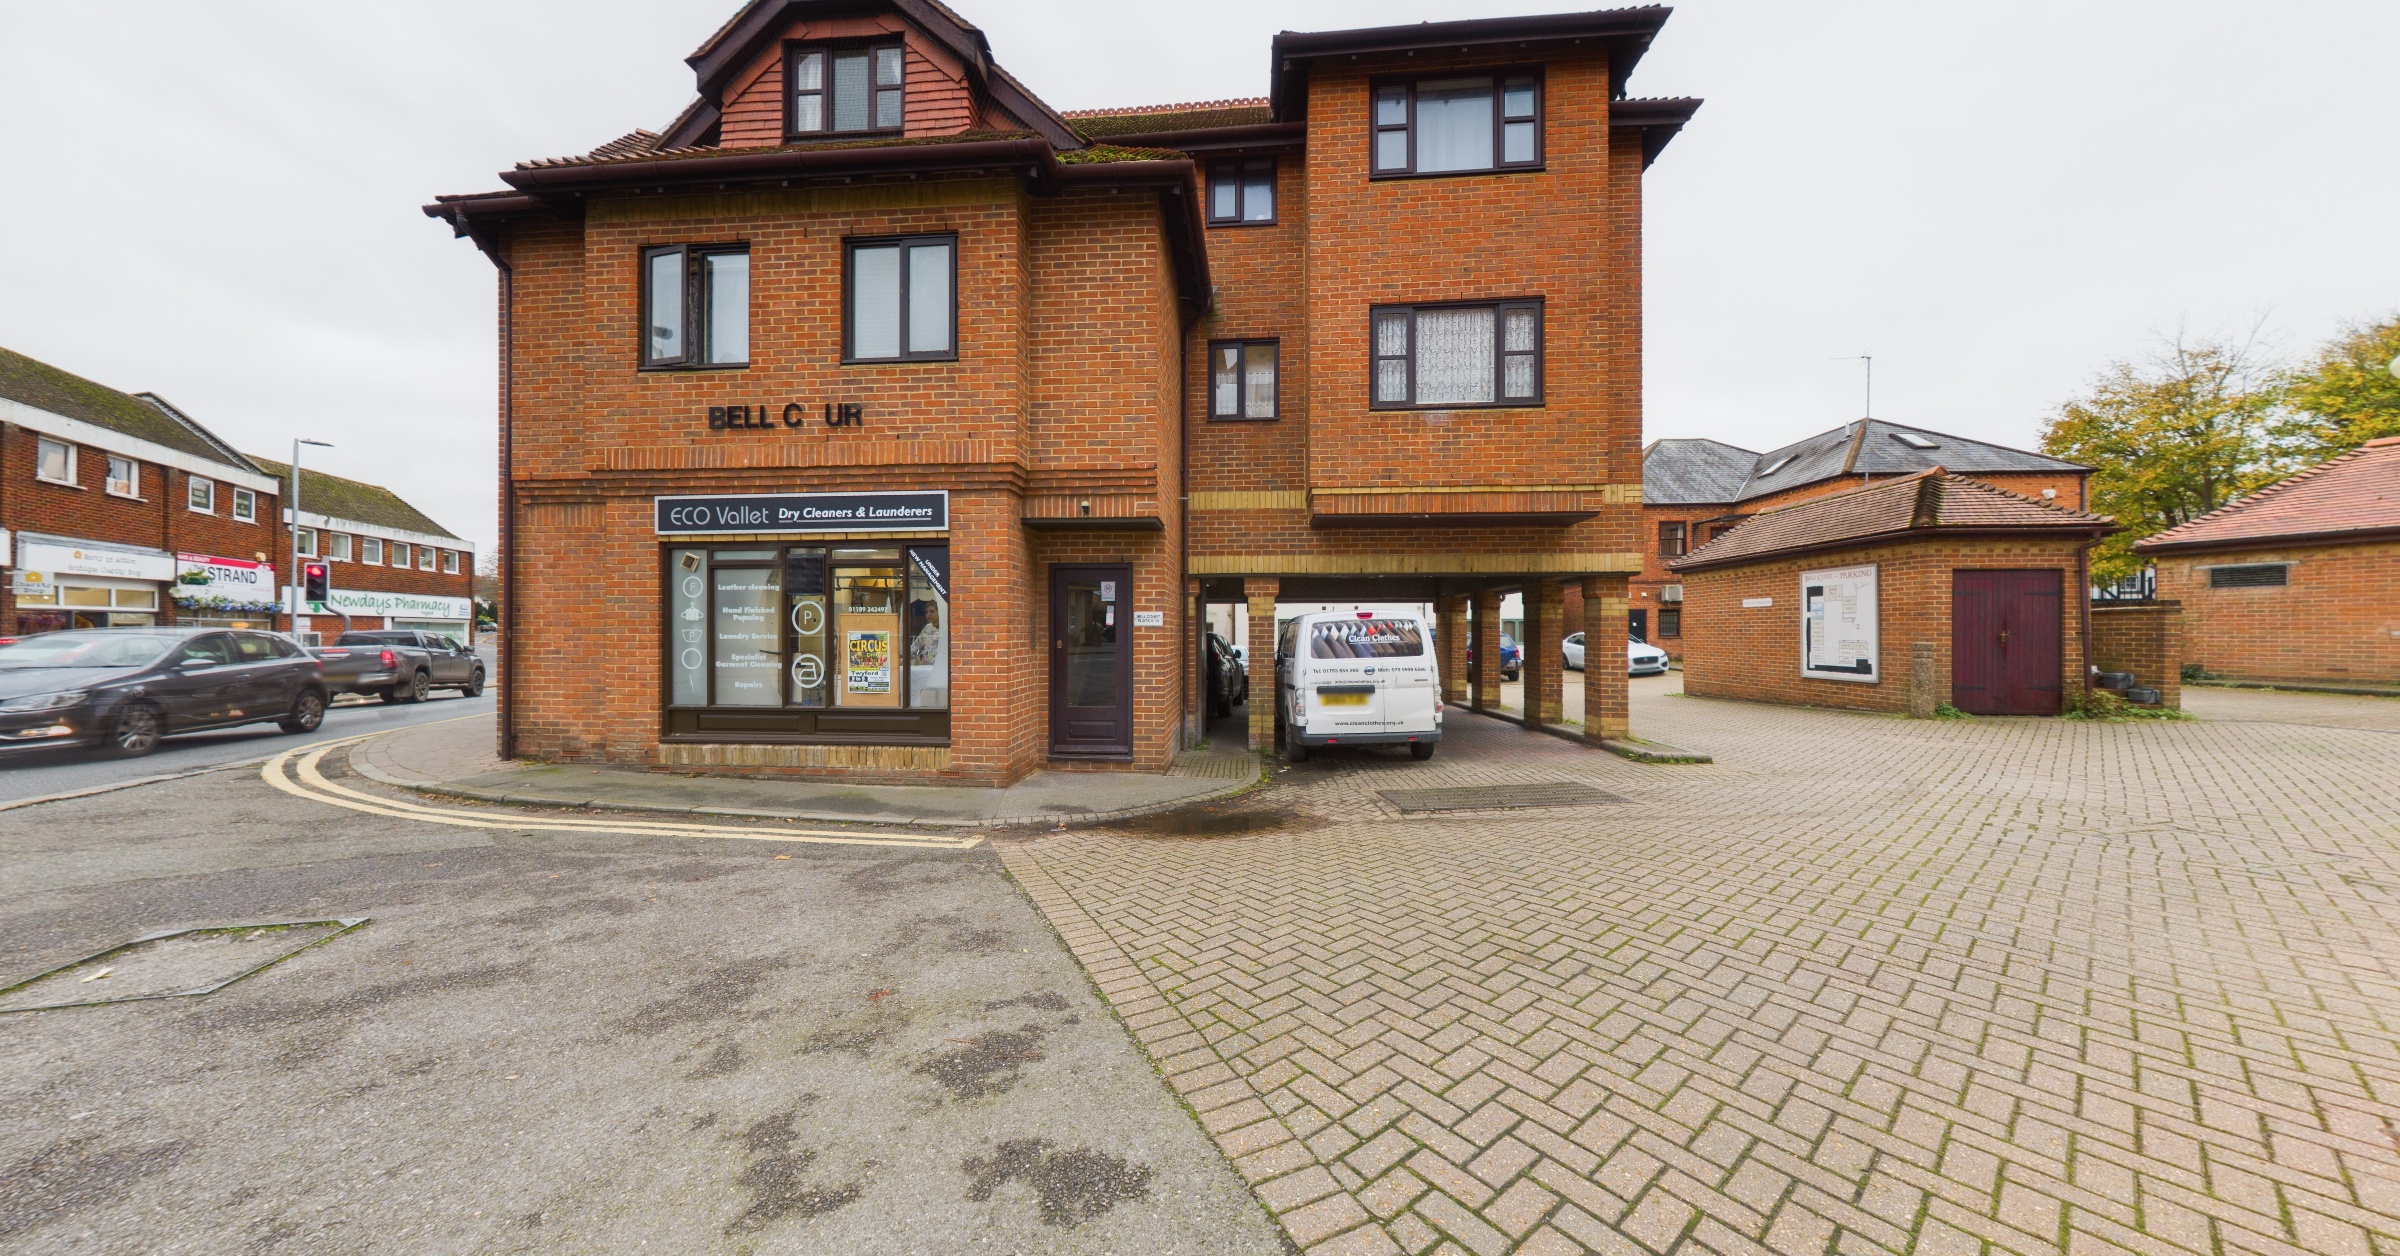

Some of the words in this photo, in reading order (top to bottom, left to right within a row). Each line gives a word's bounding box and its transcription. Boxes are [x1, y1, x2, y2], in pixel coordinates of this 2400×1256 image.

[708, 405, 775, 430] BELL
[670, 506, 711, 526] ECO
[716, 506, 770, 525] Vallet
[778, 507, 800, 522] Dry
[803, 507, 853, 519] Cleaners
[856, 507, 867, 518] &
[869, 506, 933, 518] Launderers
[207, 566, 258, 584] STRAND
[909, 549, 921, 562] NEW
[918, 560, 948, 595] MANAGEMENT
[925, 559, 941, 578] UNDER
[1840, 569, 1872, 579] PARKING
[748, 584, 780, 592] cleaning
[330, 593, 392, 616] Newdays
[394, 597, 451, 618] Pharmacy
[849, 639, 888, 653] CIRCUS
[1348, 635, 1371, 643] Clean
[1372, 634, 1401, 642] Clothes
[749, 661, 782, 669] Cleaning
